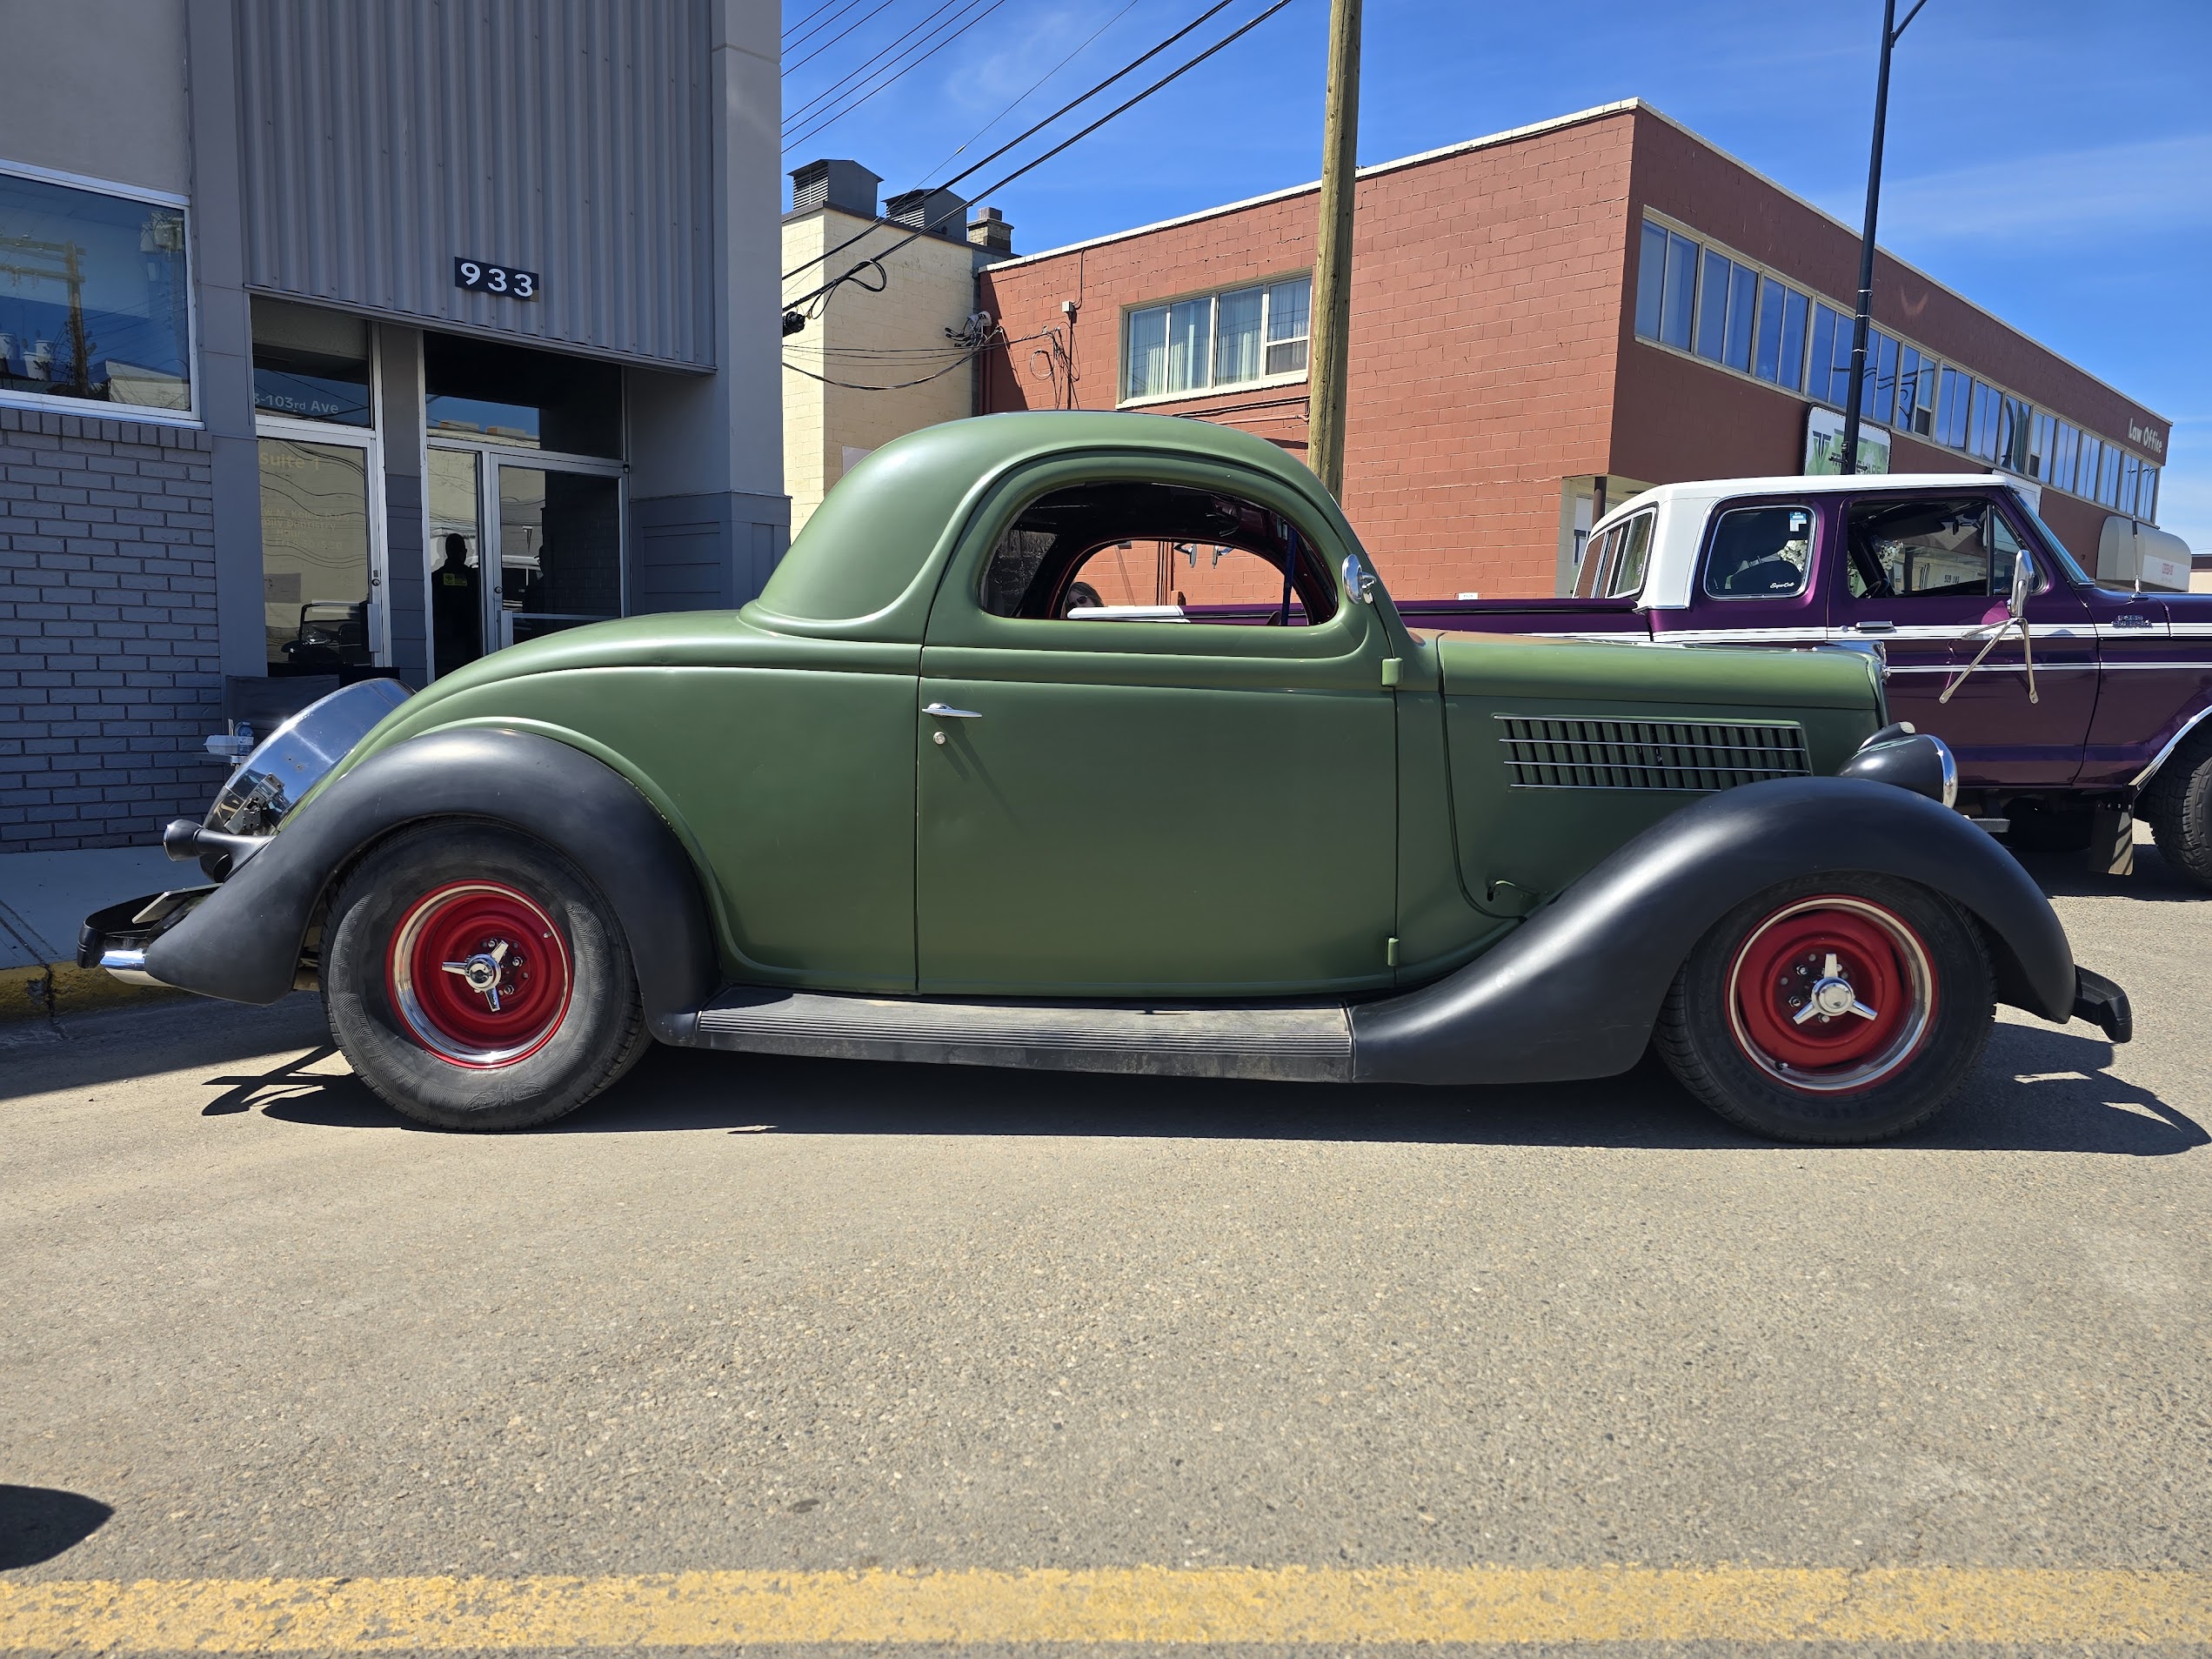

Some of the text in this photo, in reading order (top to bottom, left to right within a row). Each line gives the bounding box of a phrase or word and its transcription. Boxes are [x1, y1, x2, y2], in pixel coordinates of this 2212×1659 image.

[460, 263, 533, 298] 933
[311, 401, 339, 414] Ave
[2128, 418, 2162, 453] Law Office
[260, 452, 306, 469] Suite
